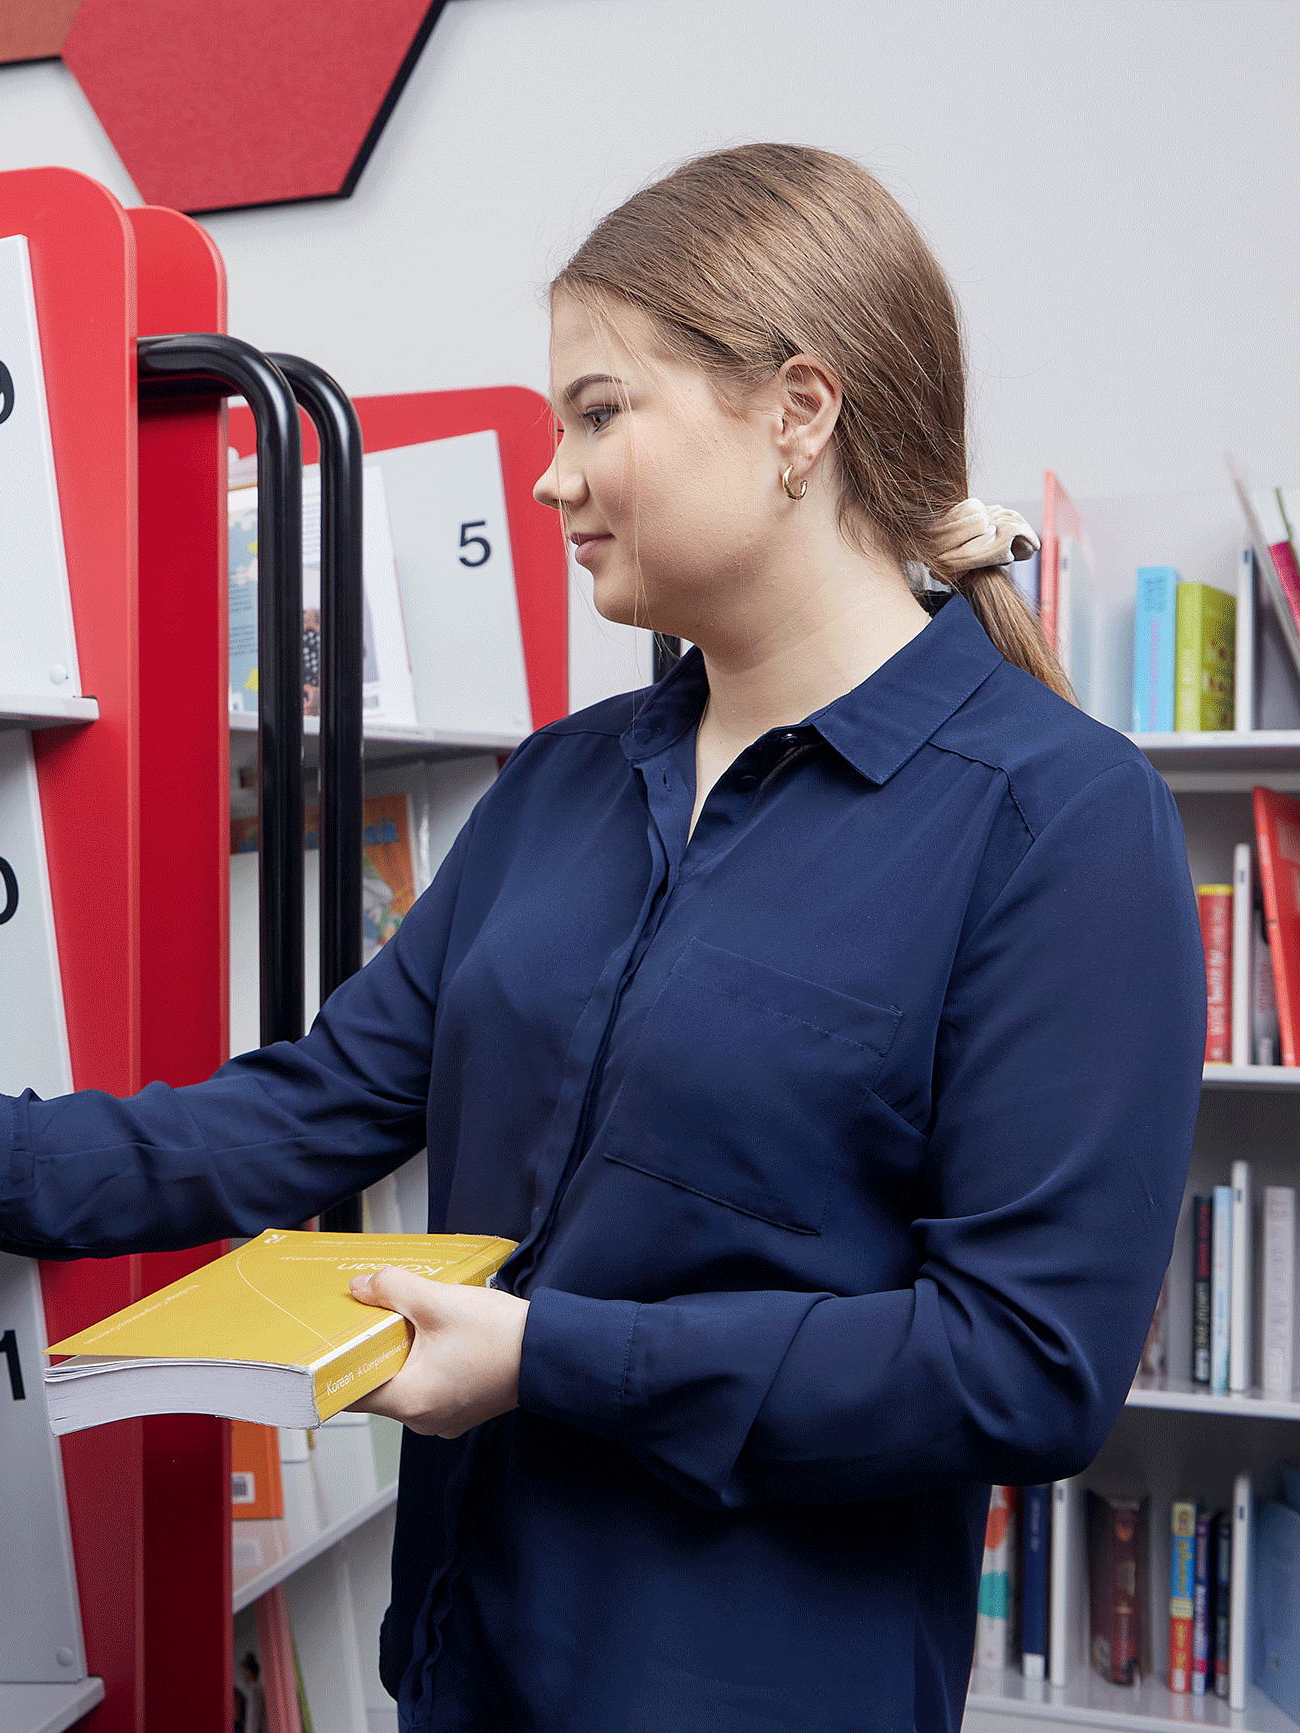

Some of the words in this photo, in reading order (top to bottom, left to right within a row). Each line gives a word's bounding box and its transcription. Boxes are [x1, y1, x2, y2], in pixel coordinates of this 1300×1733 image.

[460, 521, 490, 567] 5
[341, 1256, 441, 1265] Comprehensive
[327, 1372, 354, 1396] Korean
